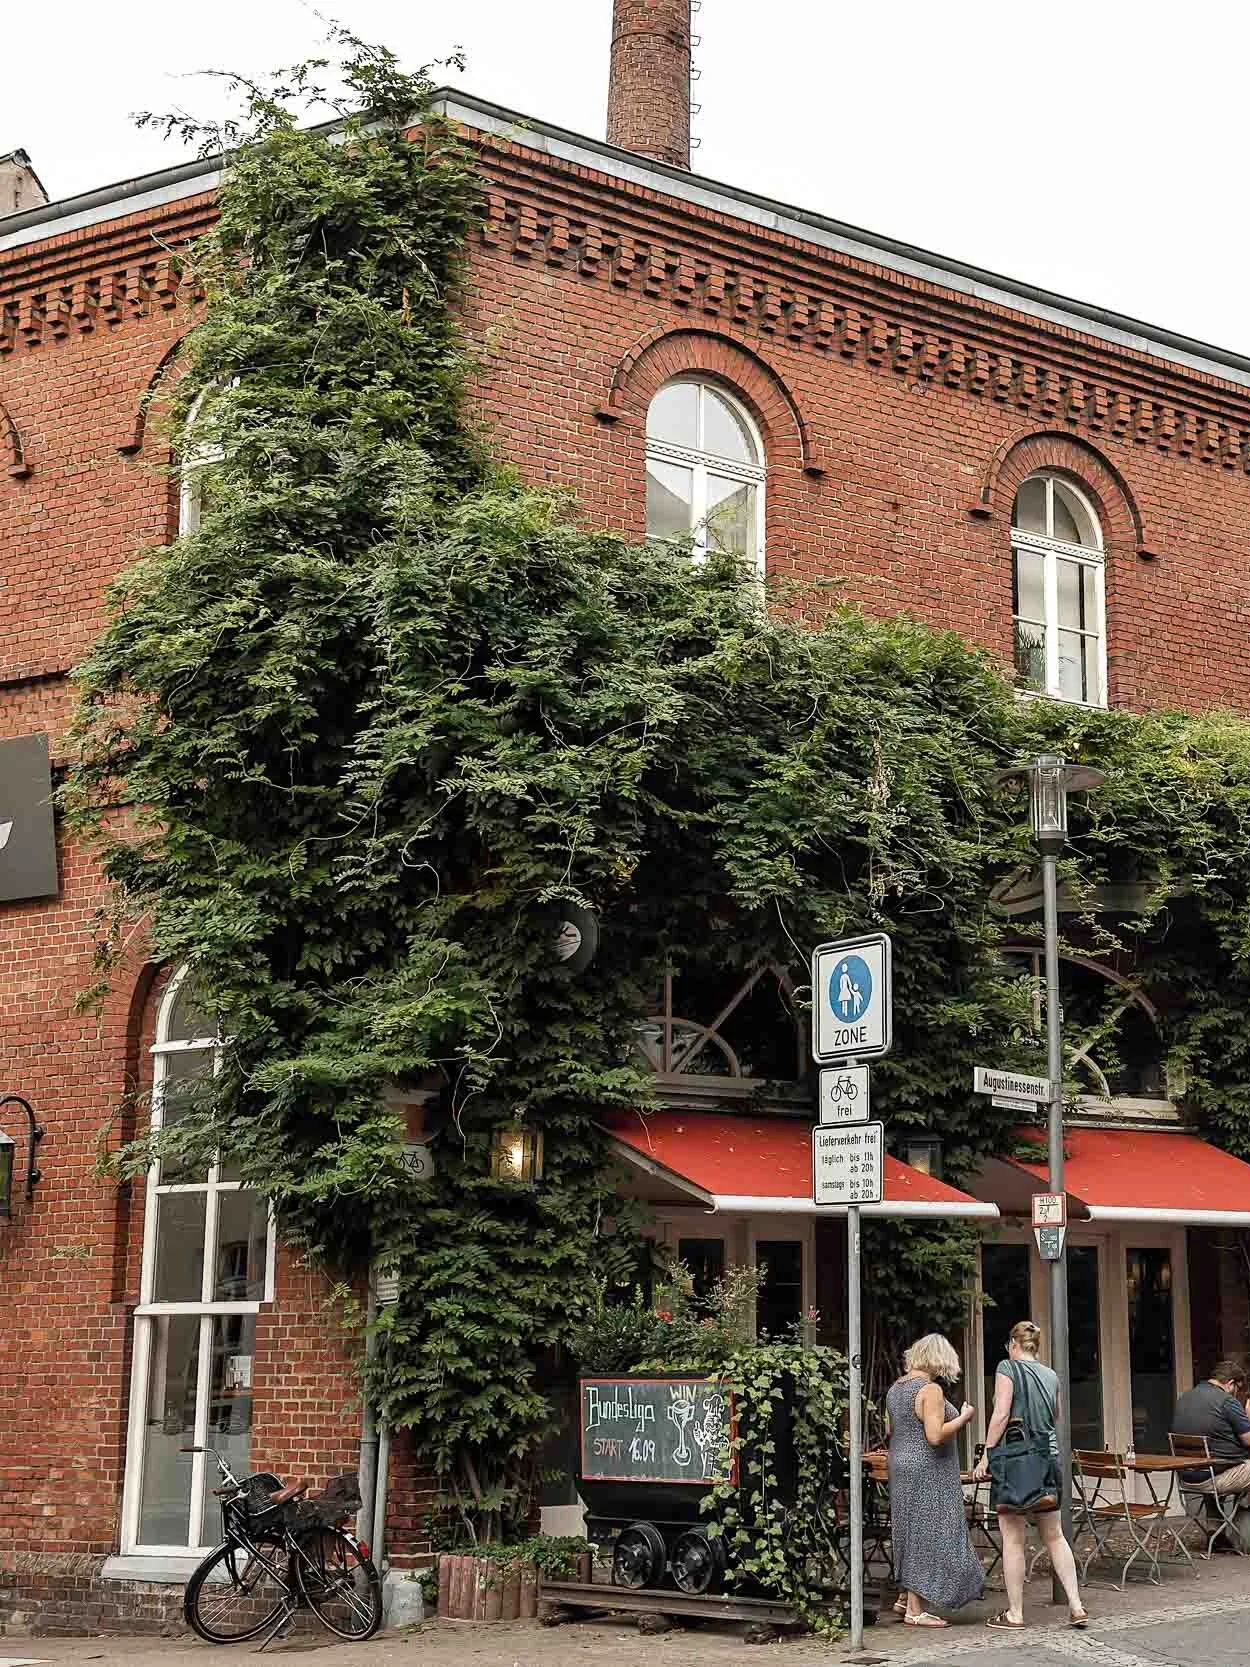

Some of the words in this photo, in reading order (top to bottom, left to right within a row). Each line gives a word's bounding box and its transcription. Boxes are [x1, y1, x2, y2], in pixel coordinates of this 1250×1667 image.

[834, 1026, 867, 1046] ZONE
[837, 1104, 852, 1117] frei
[819, 1133, 862, 1147] Lieferverkehr
[864, 1132, 876, 1144] frei
[849, 1152, 860, 1162] bis
[849, 1164, 859, 1173] ab
[861, 1163, 874, 1173] 20h
[849, 1180, 860, 1189] bis
[862, 1178, 874, 1188] 10h
[849, 1190, 859, 1200] ab
[861, 1189, 874, 1199] 20h
[669, 1384, 697, 1400] WIN
[593, 1438, 623, 1461] START
[628, 1437, 656, 1463] 16.09
